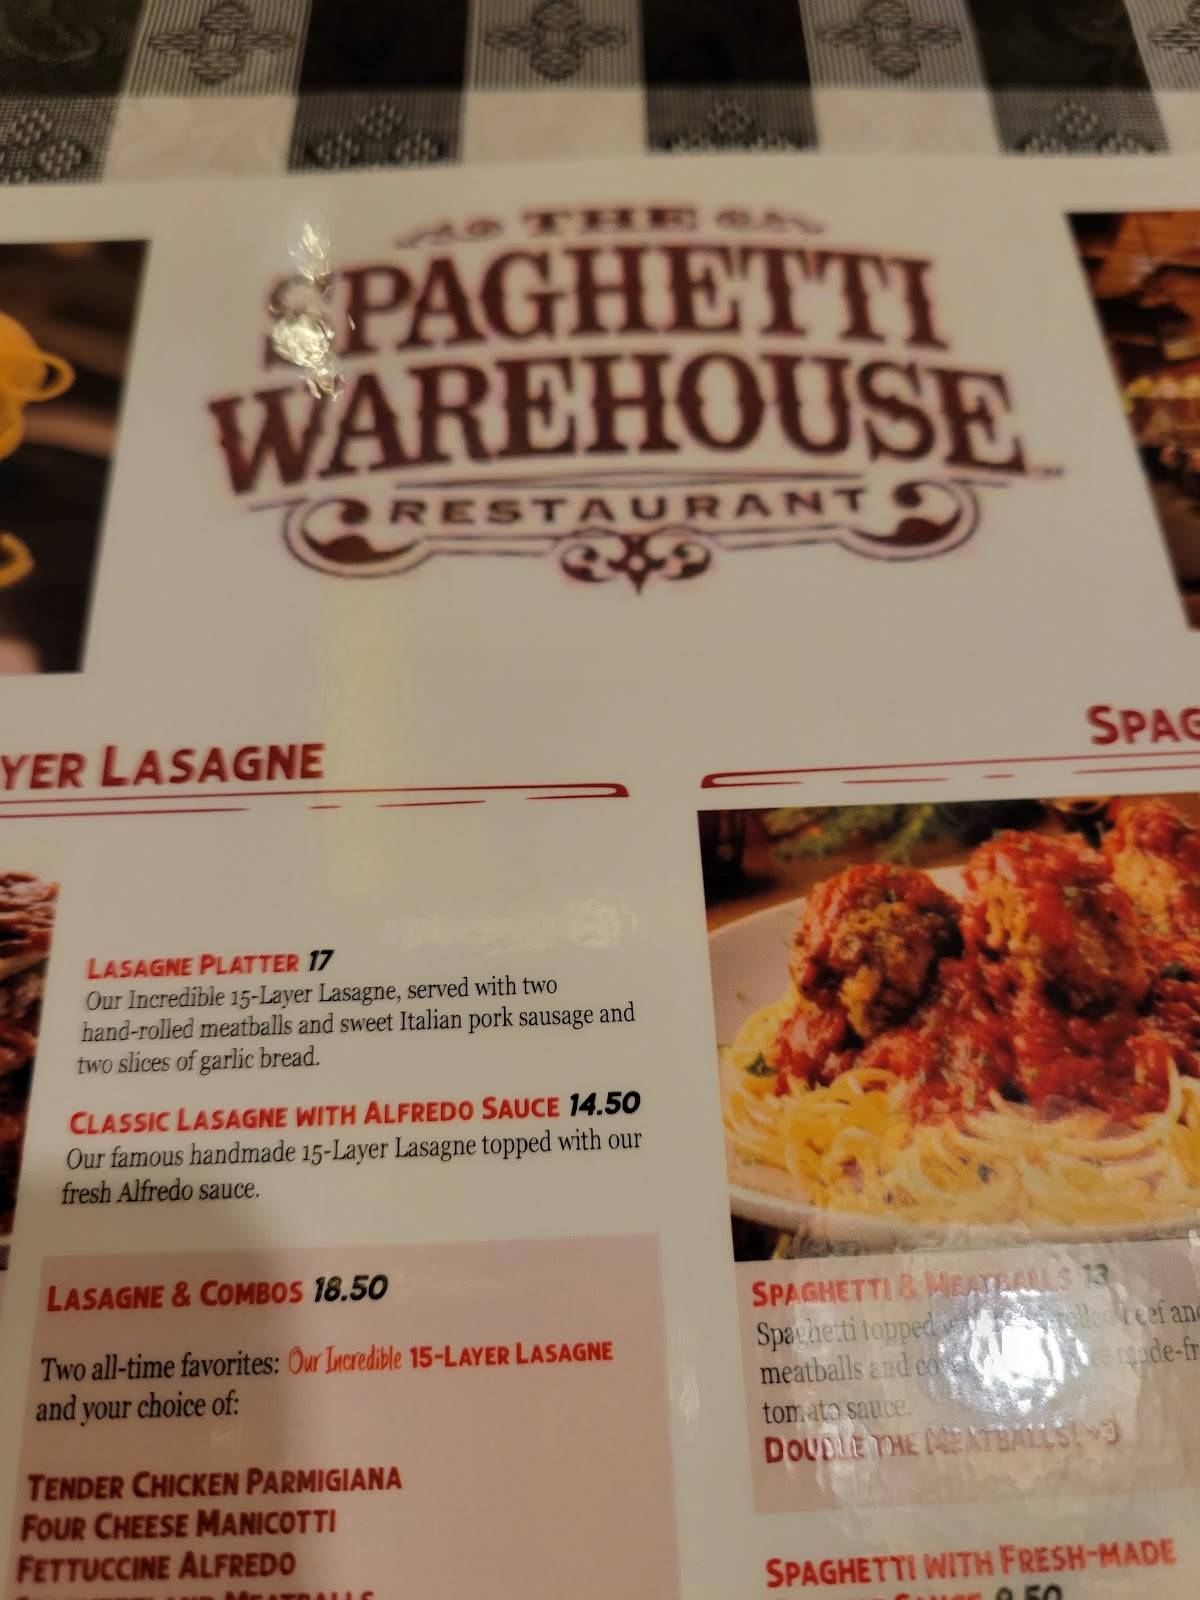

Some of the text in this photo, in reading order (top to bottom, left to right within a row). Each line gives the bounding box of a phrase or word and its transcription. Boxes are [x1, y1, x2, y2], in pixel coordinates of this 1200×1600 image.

[523, 206, 698, 236] THE
[264, 241, 950, 370] SPAGHETTI
[206, 350, 1026, 497] WAREHOUSE
[388, 486, 870, 528] RESTAURANT
[1086, 704, 1200, 746] SPAG
[100, 743, 326, 787] LASAGNE
[86, 949, 336, 980] LASAGNE PLATTER 17
[86, 975, 558, 1011] Our Incredible 15-Layer Lasagne, served with two
[81, 1001, 636, 1042] hand-rolled meatballs and sweet Italian pork sausage and
[78, 1045, 321, 1076] two slices of garlic bread.
[68, 1111, 171, 1135] CLASSIC
[177, 1106, 289, 1132] LASAGNE
[364, 1099, 474, 1125] ALFREDO
[481, 1096, 560, 1120] SAUCE
[569, 1090, 641, 1117] 14.50
[67, 1128, 642, 1170] Our famous handmade 15-Layer Lasagne topped with our
[61, 1178, 260, 1205] fresh Alfredo sauce.
[47, 1274, 389, 1312] LASAGNE & COMBOS 18.50
[752, 1278, 892, 1307] SPAGHETTI
[900, 1272, 919, 1300] &
[862, 1311, 936, 1346] topped
[41, 1340, 614, 1382] Two all-time favorites: Our Incredible 15-LAYER LASAGNE
[760, 1354, 864, 1385] meatballs
[36, 1389, 240, 1427] and your choice of:
[27, 1466, 403, 1503] TENDER CHICKEN PARMIGIANA
[20, 1508, 337, 1543] FOUR CHEESE MANICOTTI
[16, 1550, 297, 1584] FETTUCCINE ALFREDO
[766, 1554, 916, 1589] SPAGHETTI
[999, 1537, 1178, 1576] FRESH-MADE
[995, 1584, 1064, 1600] 950
